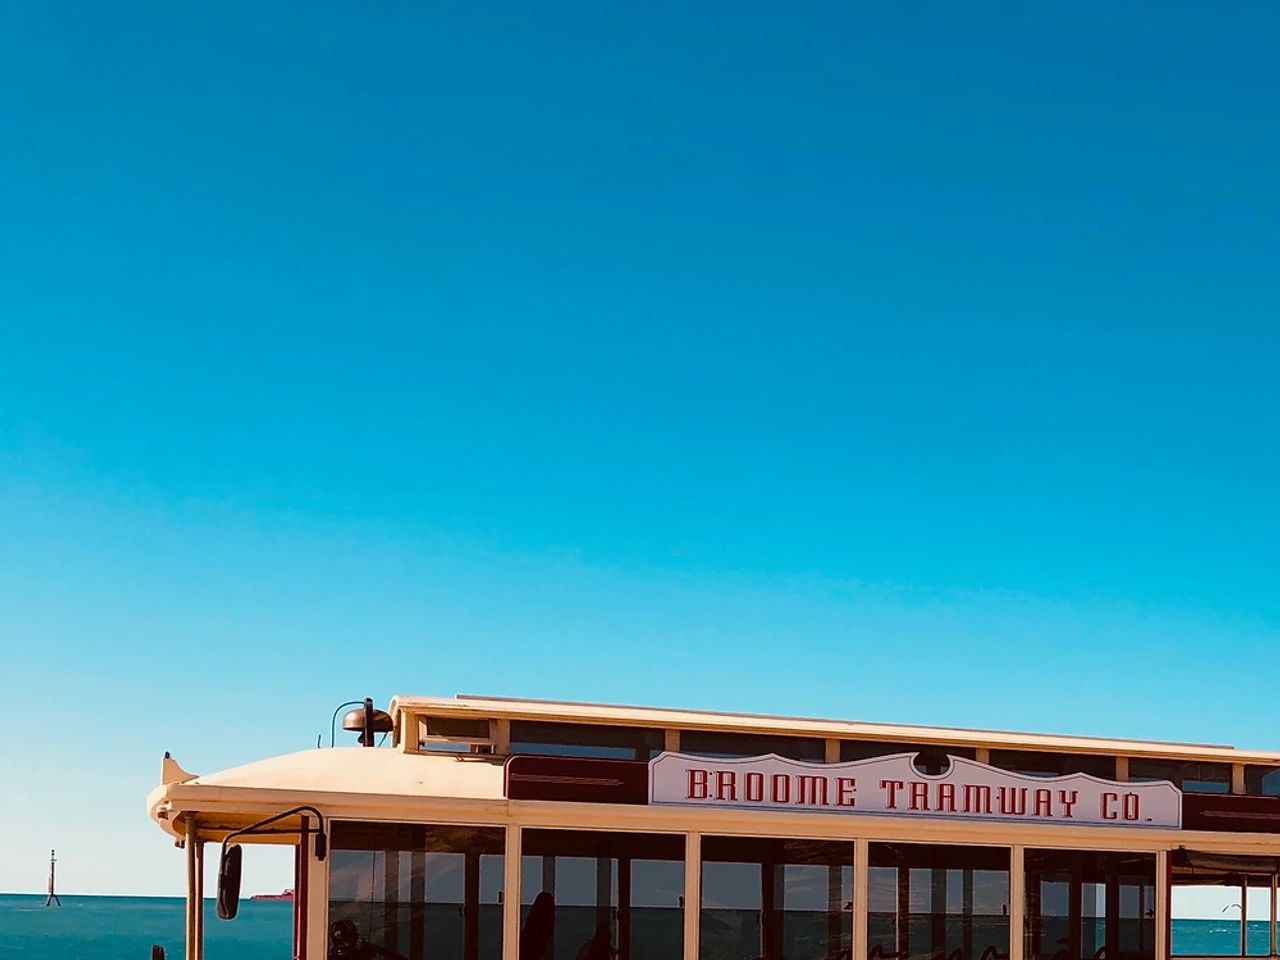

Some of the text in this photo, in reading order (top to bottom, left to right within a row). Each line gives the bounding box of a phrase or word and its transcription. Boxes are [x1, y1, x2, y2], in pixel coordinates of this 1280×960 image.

[687, 769, 1153, 822] BROOME TRAMWAY CO.
